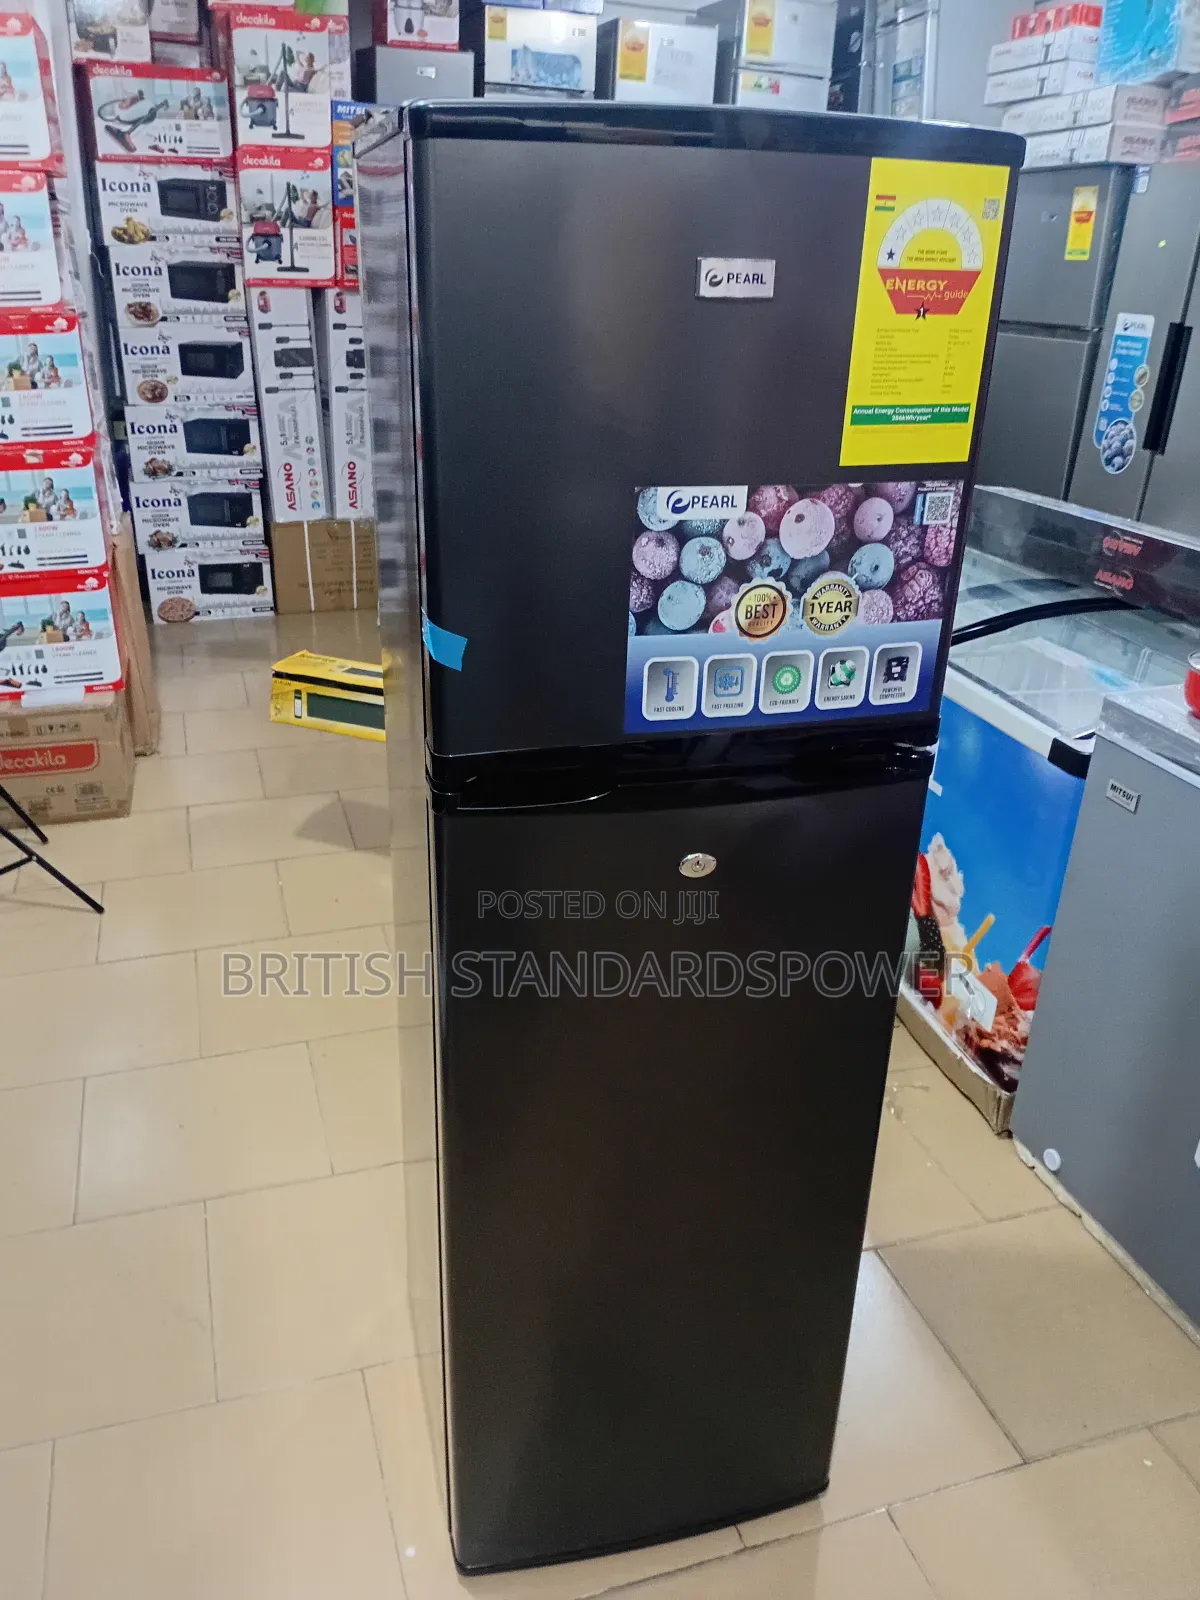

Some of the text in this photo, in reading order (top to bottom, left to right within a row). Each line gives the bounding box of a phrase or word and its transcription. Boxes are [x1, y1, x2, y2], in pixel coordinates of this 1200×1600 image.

[236, 12, 276, 26] decakila
[242, 154, 281, 167] decakila
[101, 177, 151, 193] Icona
[115, 262, 162, 277] Icona
[726, 272, 767, 285] PEARL
[886, 276, 948, 295] ENERGY
[943, 289, 969, 301] guide
[123, 342, 170, 356] Icona
[875, 407, 894, 415] Energy
[895, 406, 933, 414] Consumption
[130, 422, 178, 435] Icona
[283, 462, 297, 511] ASANO
[347, 461, 358, 510] ASANO
[134, 496, 182, 508] Icona
[691, 495, 738, 509] PEARL
[151, 568, 195, 580] Icona
[753, 593, 773, 603] 100%
[814, 583, 850, 599] WARRANTY
[745, 603, 779, 620] BEST
[809, 600, 853, 615] 1 YEAR
[811, 616, 849, 632] WARRANTY
[1109, 783, 1135, 802] MITSUI
